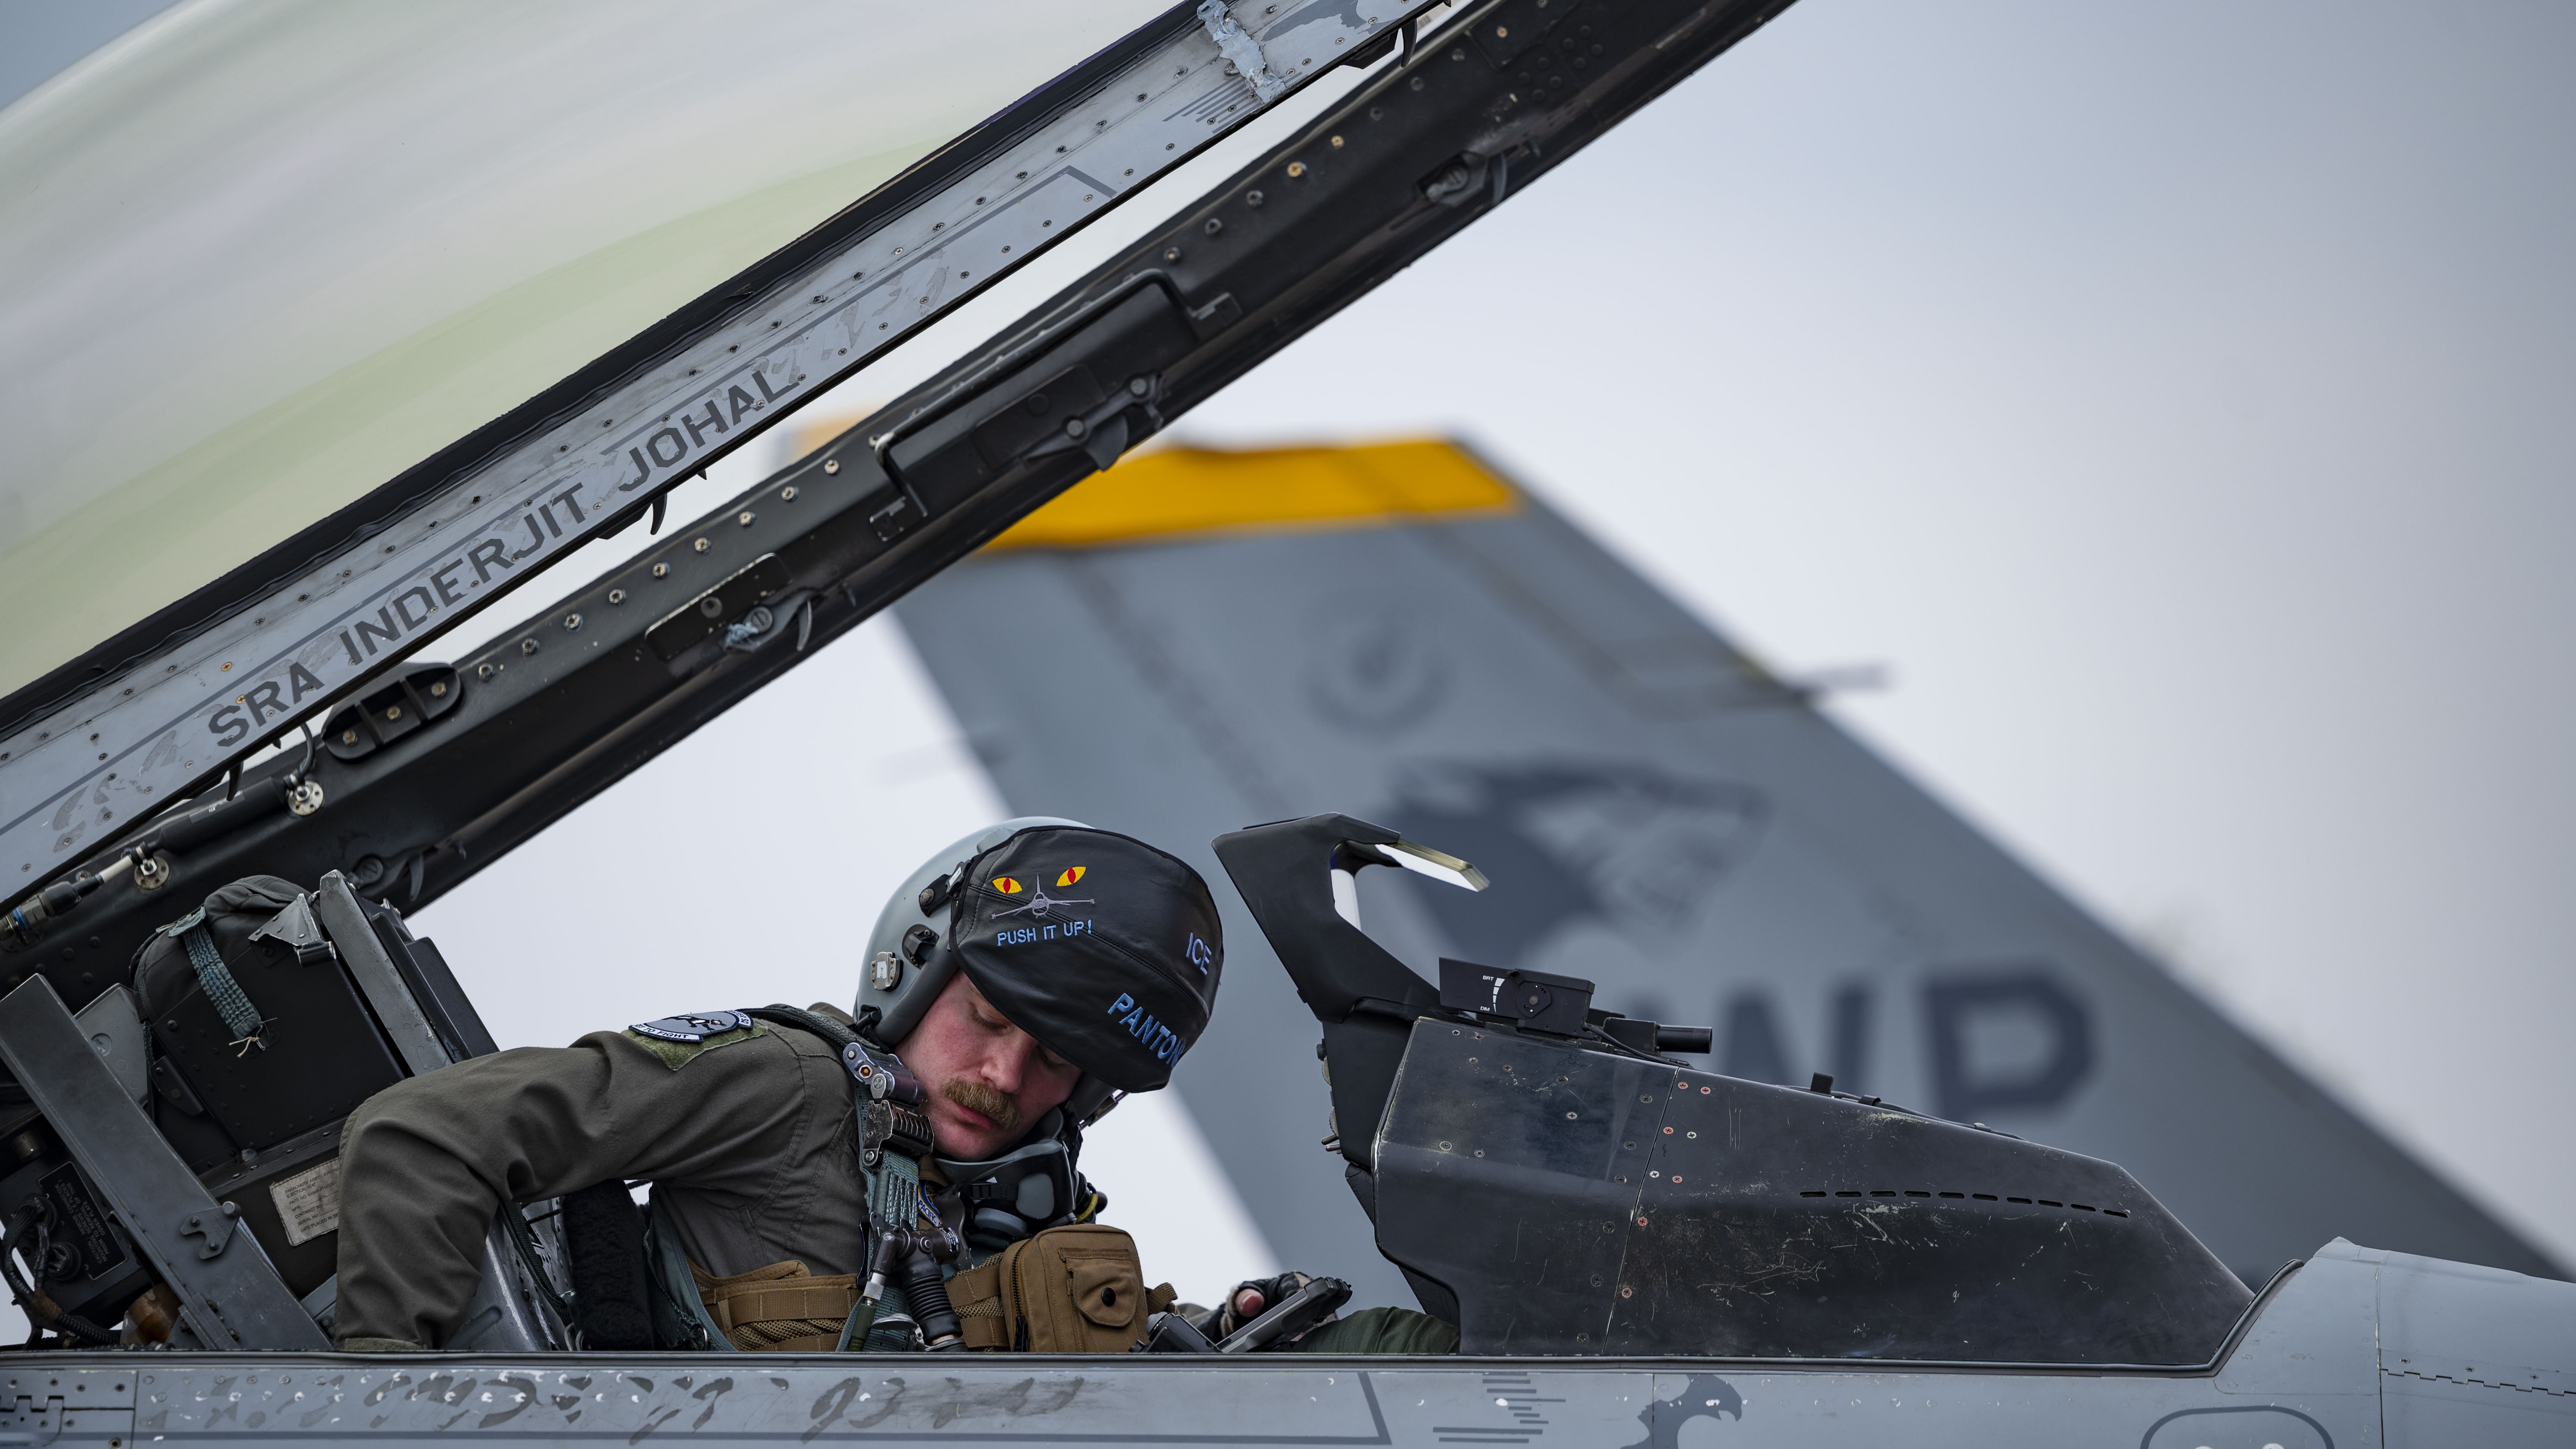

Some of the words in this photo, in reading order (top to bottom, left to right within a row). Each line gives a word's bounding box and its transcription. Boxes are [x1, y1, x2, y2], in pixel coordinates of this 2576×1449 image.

[208, 662, 325, 747] SRA
[340, 482, 586, 665] INDERJIT
[618, 370, 800, 492] JOHAL
[997, 927, 1037, 946] PUSH
[1044, 924, 1057, 940] IT
[1186, 932, 1212, 975] ICE
[66, 1183, 75, 1193] THIS
[285, 1181, 309, 1193] PARACHUTE
[287, 1187, 306, 1198] EJECTION
[79, 1205, 94, 1228] REMOVAL
[295, 1207, 316, 1218] CONTRACT
[297, 1217, 311, 1225] SERIAL
[78, 1213, 91, 1233] SCREWS
[93, 1218, 105, 1235] COVER
[311, 1218, 327, 1227] PLACED
[90, 1235, 107, 1261] MOUNTING
